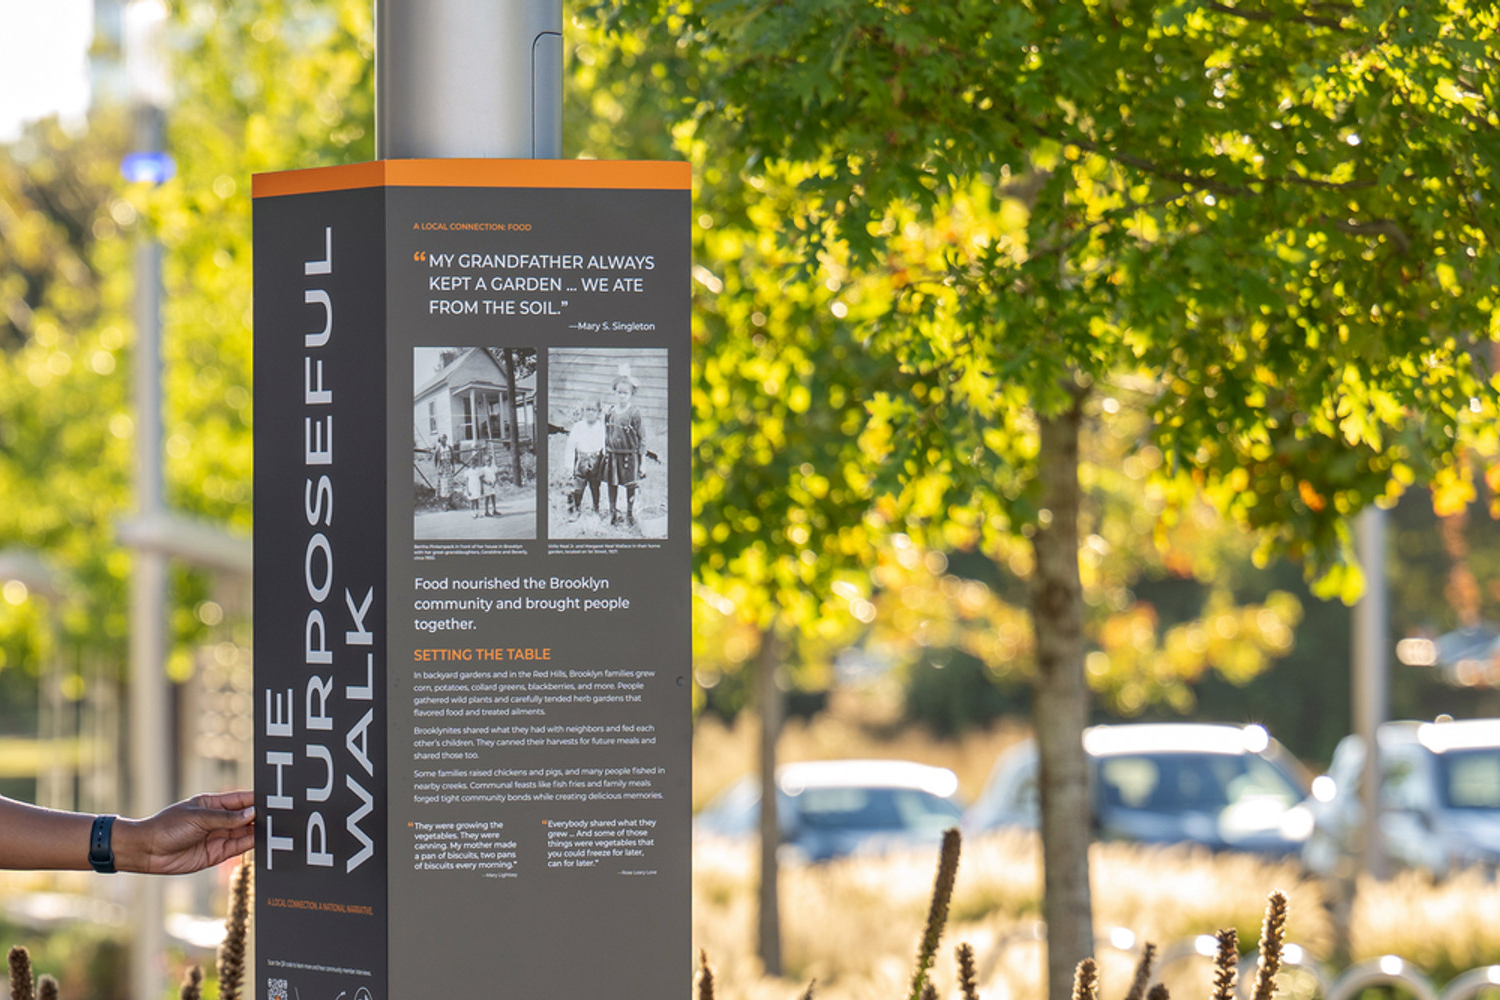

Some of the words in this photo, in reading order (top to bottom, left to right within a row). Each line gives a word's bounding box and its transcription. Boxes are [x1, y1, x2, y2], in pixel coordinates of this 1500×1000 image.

[459, 254, 583, 269] GRANDFATHER
[587, 255, 654, 269] ALWAYS
[430, 276, 471, 290] KEPT
[475, 277, 487, 290] A
[491, 277, 561, 291] GARDEN
[581, 278, 608, 292] WE
[613, 278, 643, 292] ATE
[430, 300, 478, 314] FROM
[483, 300, 515, 314] THE
[603, 322, 610, 330] S.
[612, 322, 655, 332] Singleton
[305, 227, 334, 866] PURPOSEFUL
[415, 578, 448, 590] Food
[453, 577, 520, 589] nourished
[524, 577, 546, 589] the
[550, 577, 608, 591] Brooklyn
[414, 597, 493, 612] community
[496, 597, 521, 609] and
[526, 597, 580, 612] brought
[584, 597, 629, 611] people
[414, 618, 476, 633] together.
[414, 649, 472, 661] SETTING
[476, 649, 503, 660] THE
[507, 648, 550, 660] TABLE
[423, 671, 458, 680] backyard
[460, 671, 491, 680] gardens
[570, 670, 603, 679] Brooklyn
[618, 682, 644, 690] People
[414, 696, 449, 706] gathered
[469, 696, 492, 704] plants
[510, 695, 542, 704] carefully
[593, 695, 624, 704] gardens
[346, 585, 374, 874] WALK
[414, 726, 461, 736] Brooklynites
[512, 726, 529, 735] they
[566, 725, 604, 734] neighbors
[476, 738, 495, 747] They
[605, 767, 630, 776] people
[266, 688, 294, 870] THE
[414, 782, 440, 792] nearby
[604, 780, 626, 788] family
[414, 795, 439, 804] forged
[461, 794, 506, 803] community
[555, 793, 587, 802] creating
[456, 821, 488, 831] growing
[590, 819, 616, 830] shared
[617, 819, 637, 829] what
[639, 819, 656, 828] they
[460, 831, 479, 841] They
[450, 842, 462, 850] My
[548, 840, 572, 849] things
[595, 839, 636, 849] vegetables
